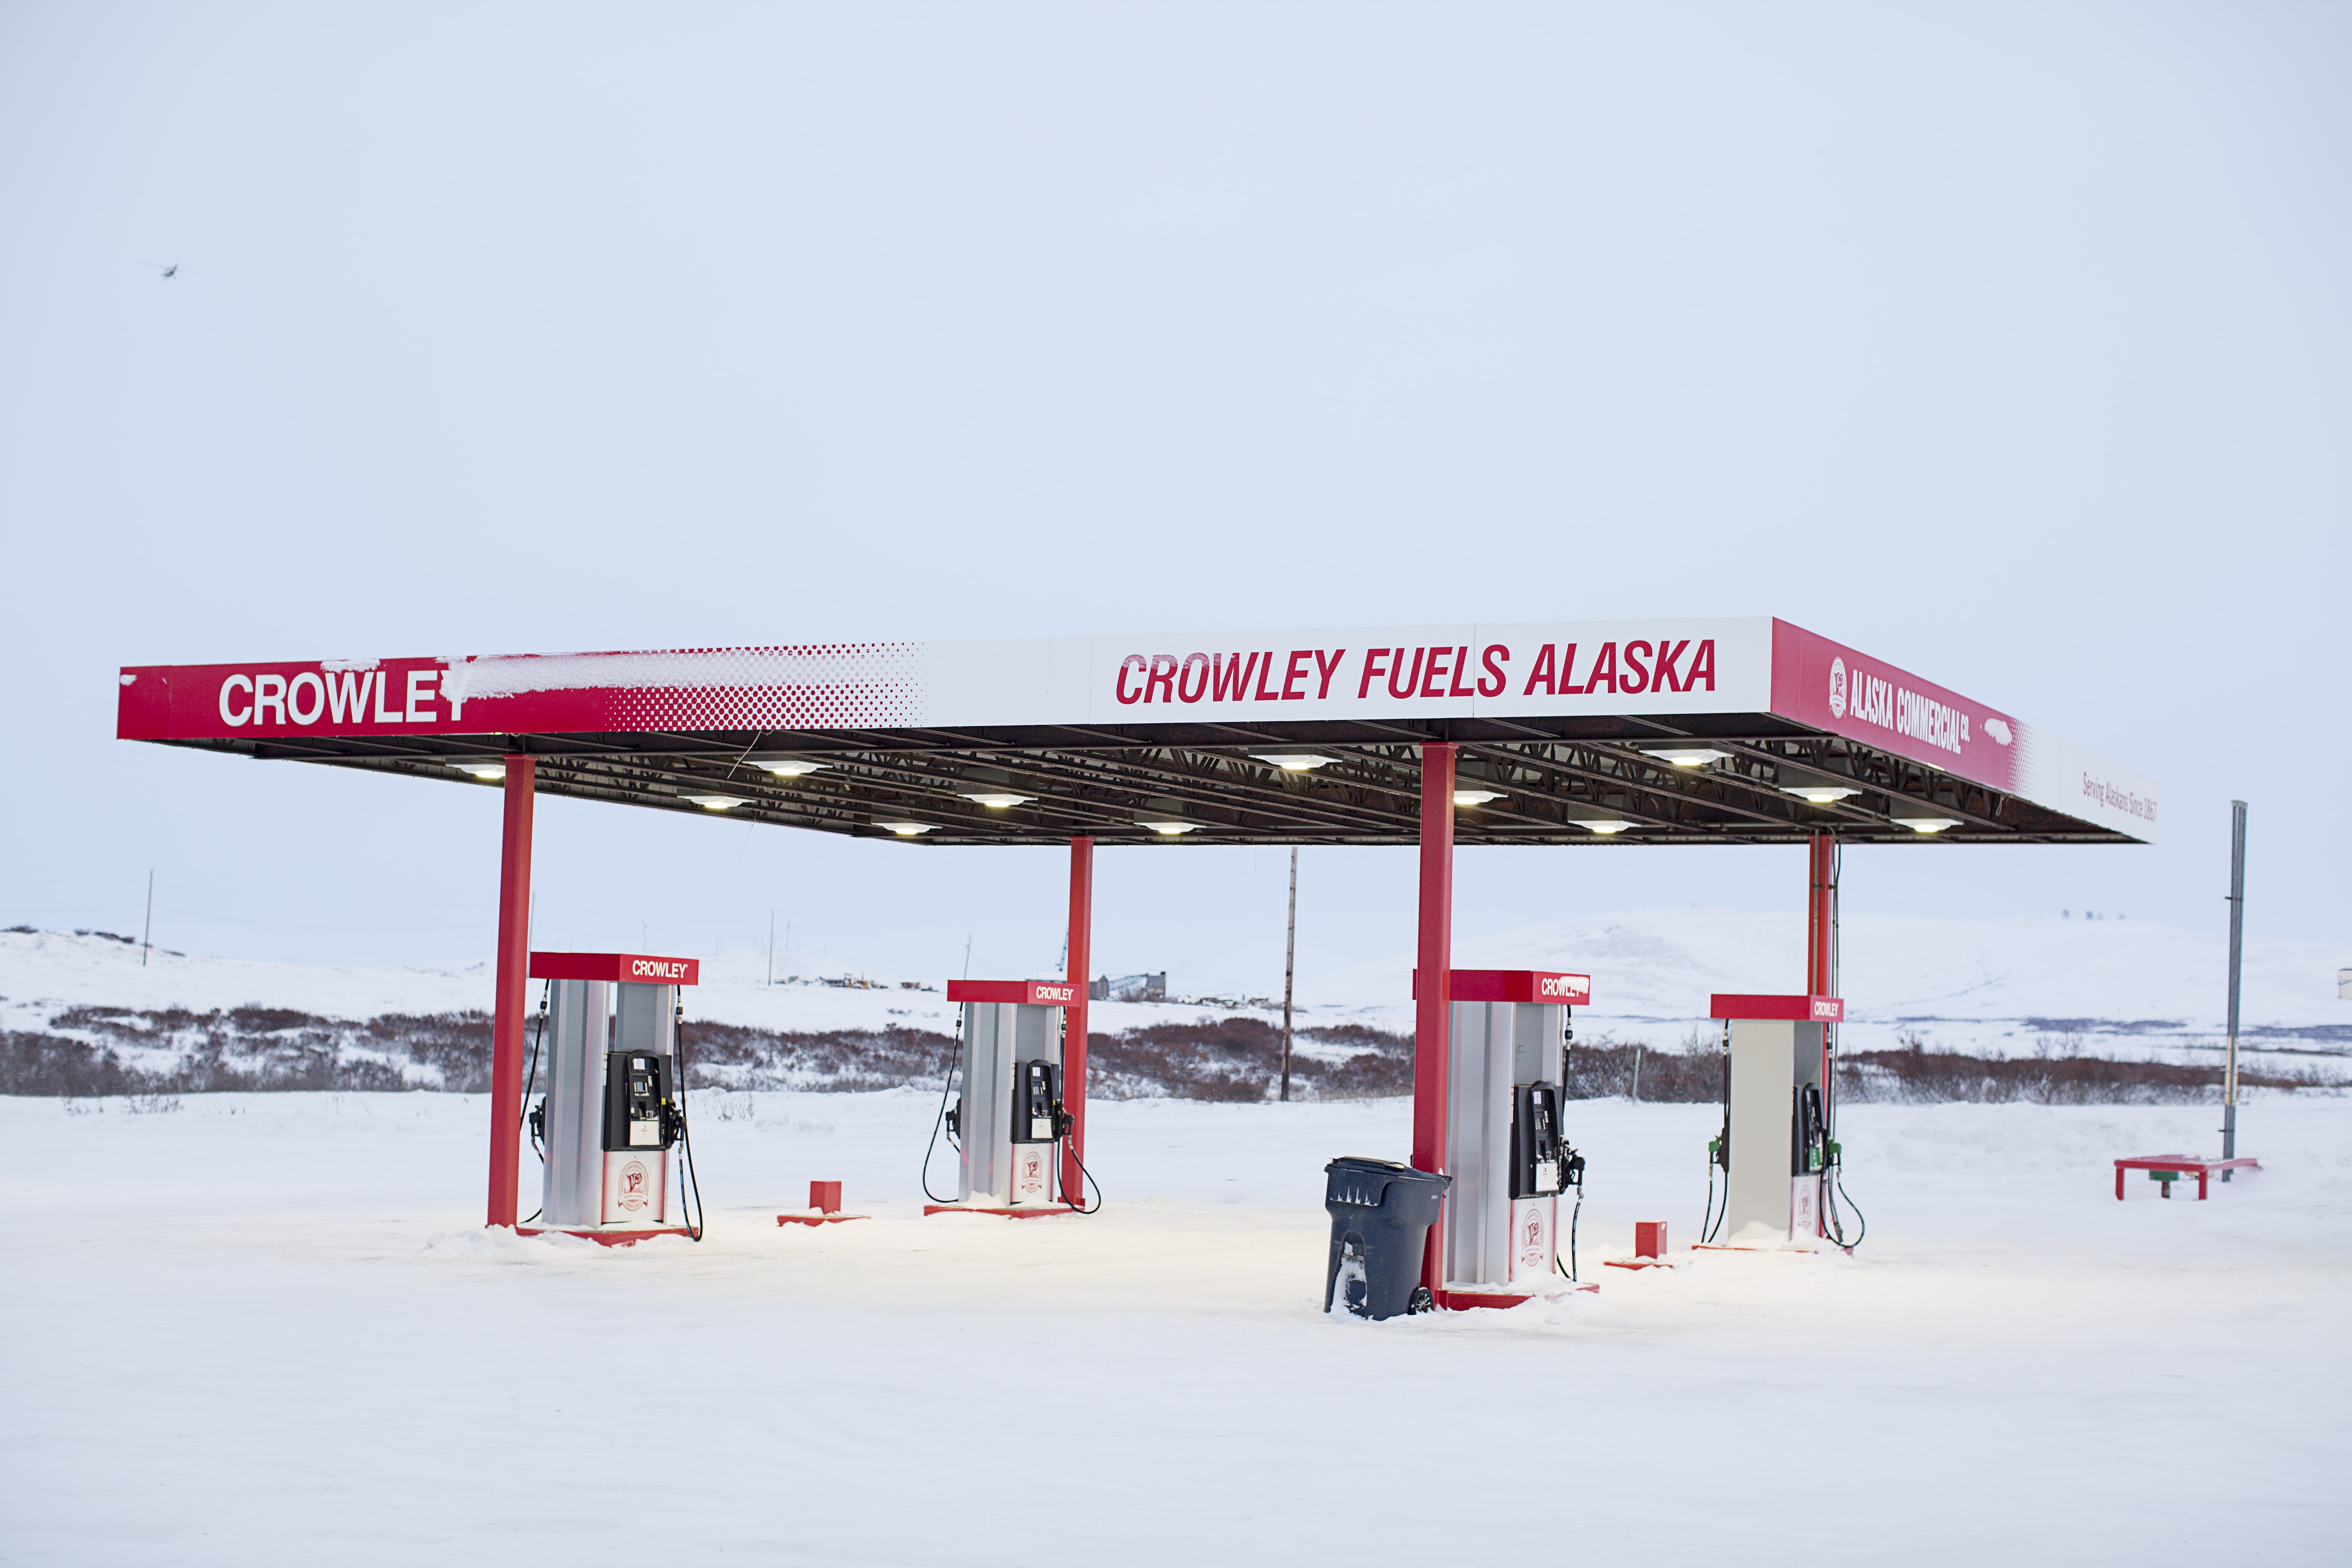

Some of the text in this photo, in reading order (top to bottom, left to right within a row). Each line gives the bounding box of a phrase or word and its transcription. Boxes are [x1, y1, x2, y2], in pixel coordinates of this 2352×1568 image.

[1116, 639, 1715, 705] CROWLEY FUELS ALASKA
[1850, 669, 1893, 730] ALASKA
[1897, 687, 1961, 754] COMMERCIAL
[1960, 713, 1970, 742] CO.
[2083, 771, 2157, 822] Serving Alaskans Since 1867
[633, 960, 687, 978] CROWLEY
[1036, 986, 1073, 1001] CROWLEY
[1815, 1001, 1839, 1017] CROWLEY
